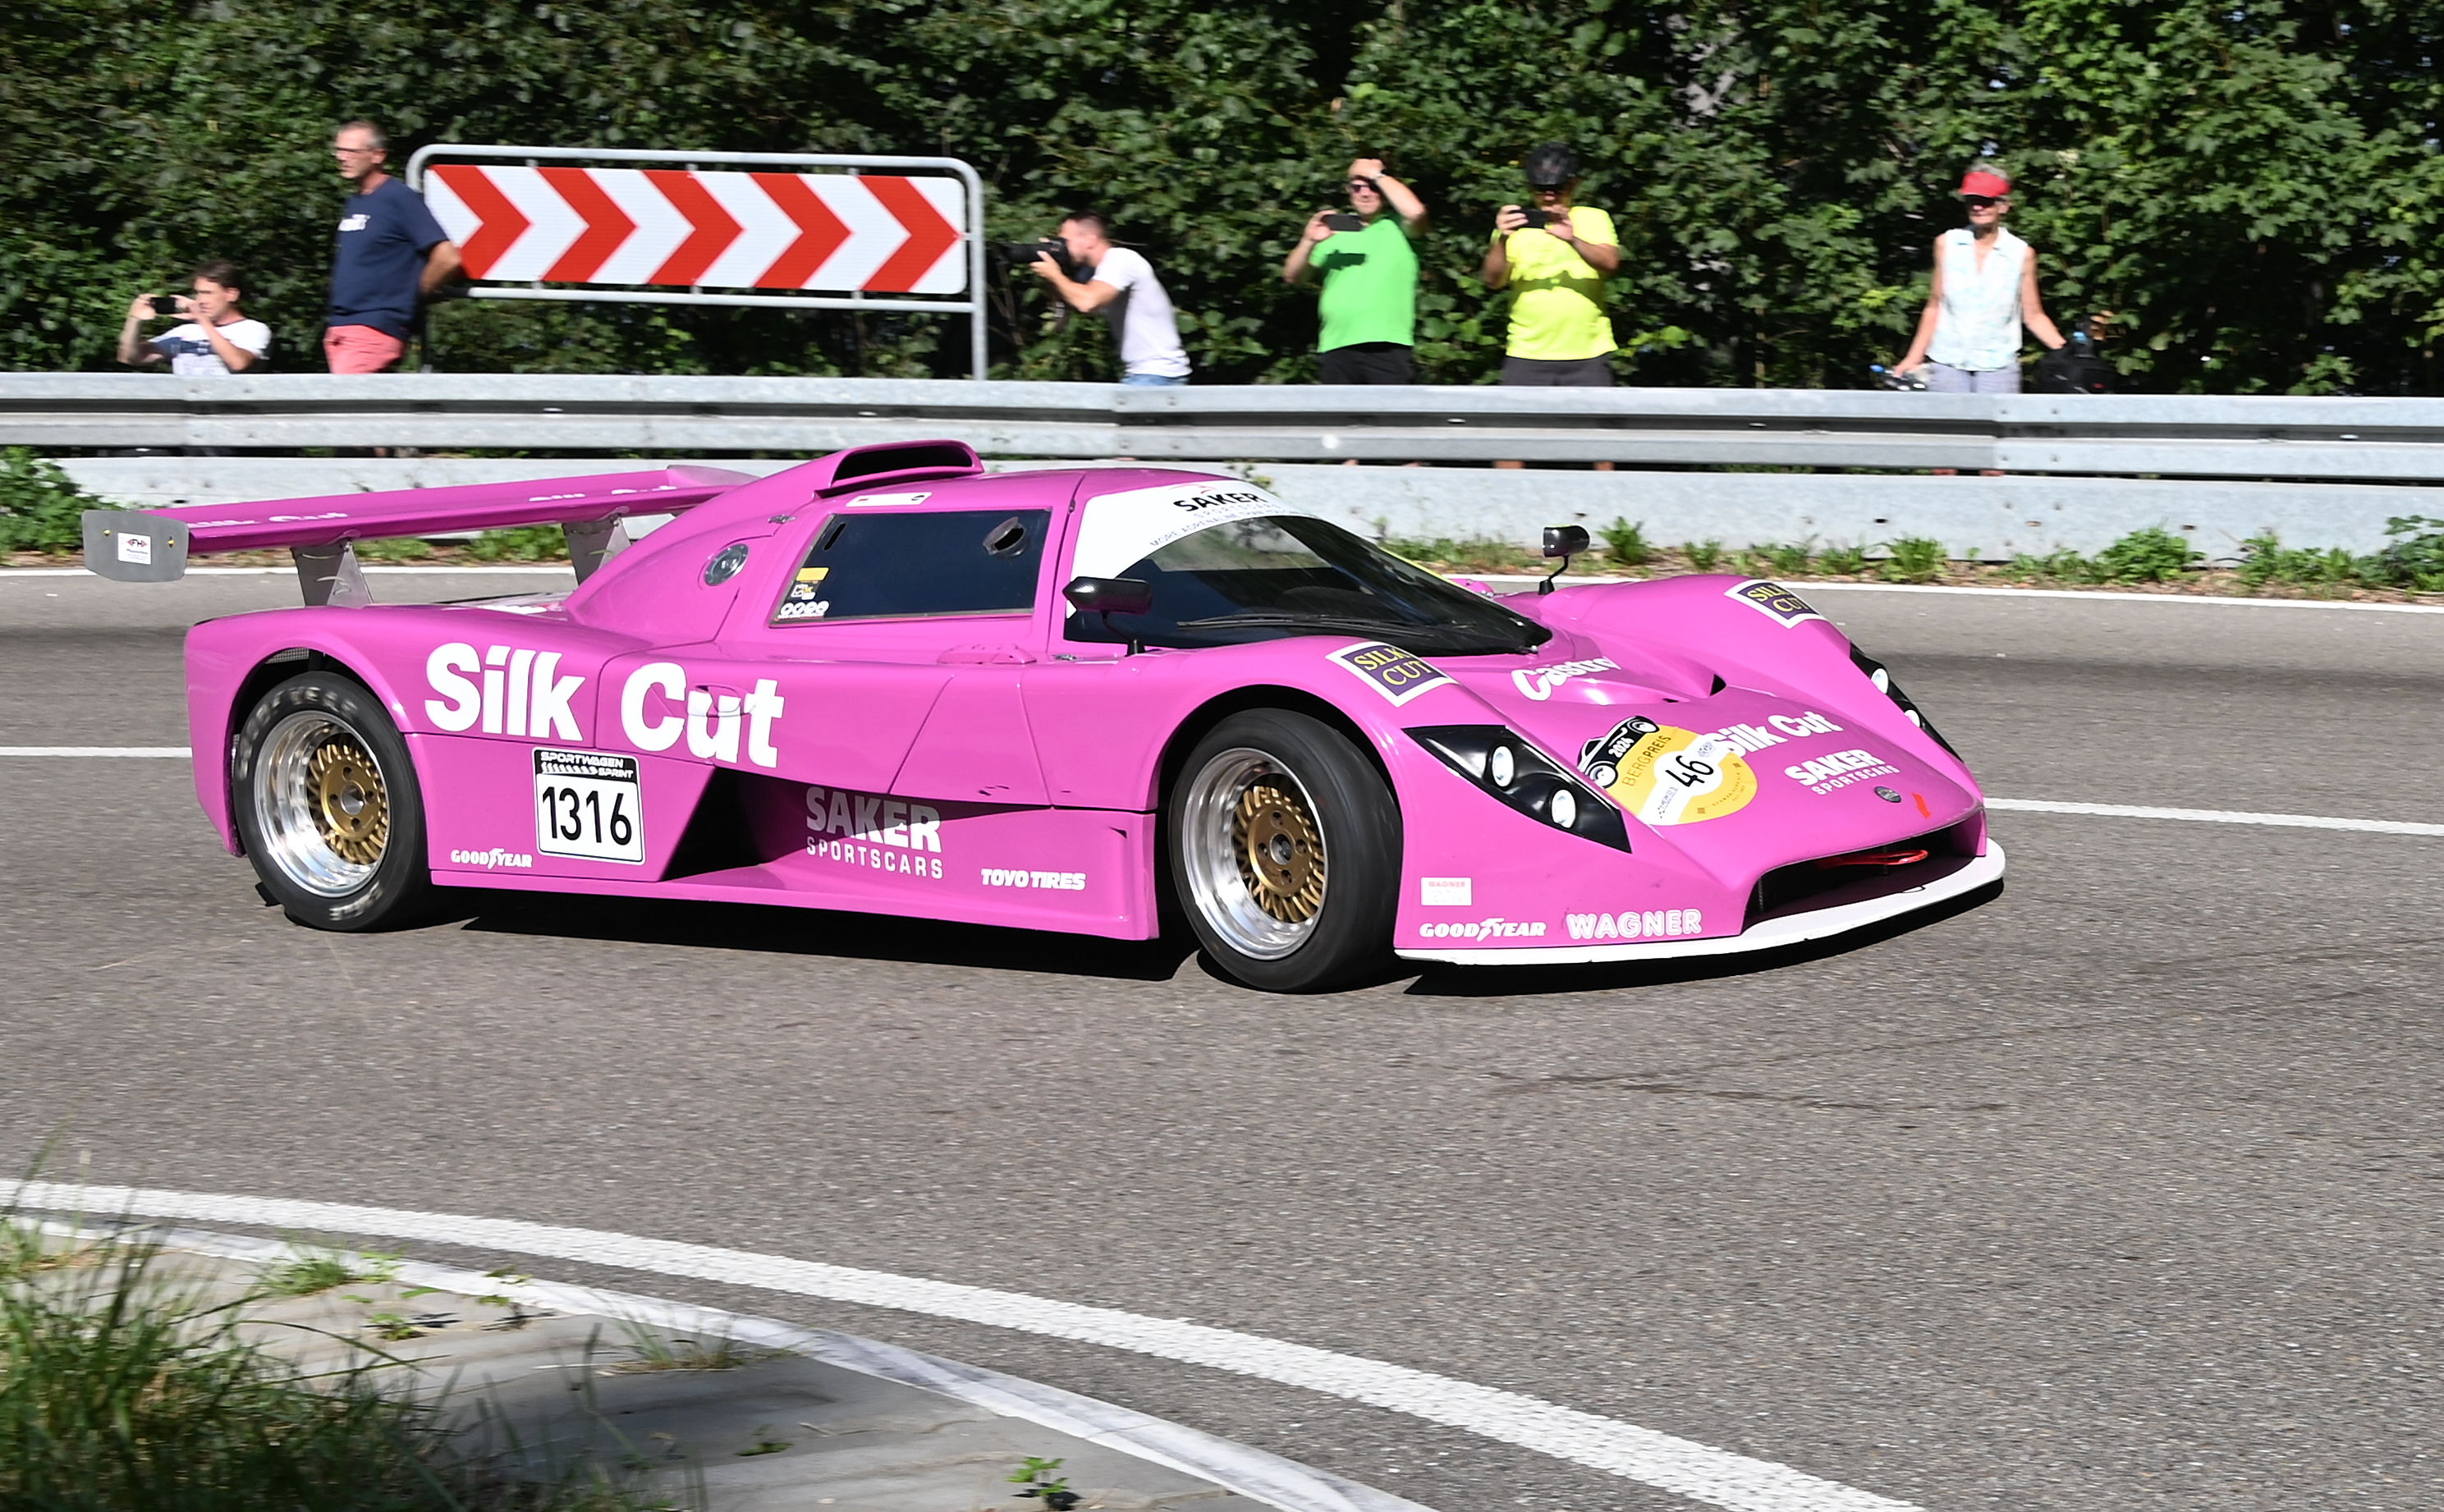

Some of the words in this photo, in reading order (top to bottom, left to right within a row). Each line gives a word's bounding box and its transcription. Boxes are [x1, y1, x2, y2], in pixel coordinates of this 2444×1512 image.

[1173, 493, 1268, 511] SAKER
[1354, 648, 1410, 671] SILK
[1382, 660, 1432, 685] CUT
[424, 642, 586, 741] Silk
[621, 662, 786, 768] Cut
[1608, 737, 1635, 758] 2024
[1708, 723, 1788, 758] Silk
[1768, 711, 1844, 737] Cut
[541, 751, 624, 768] SPORTWAGEN
[598, 767, 634, 779] SPRINT
[1621, 735, 1671, 786] BERGPREIS
[1665, 754, 1714, 787] 46
[1784, 749, 1886, 786] SAKER
[1811, 764, 1901, 795] SPORTSCARS
[542, 786, 632, 846] 1316
[806, 786, 942, 853] SAKER
[451, 848, 533, 869] GOODYEAR
[806, 836, 943, 880] SPORTSCARS
[981, 868, 1029, 887] TOYO
[1029, 870, 1087, 891] TIRES
[1419, 917, 1547, 942] GOODYEAR
[1566, 908, 1703, 941] WAGNER
